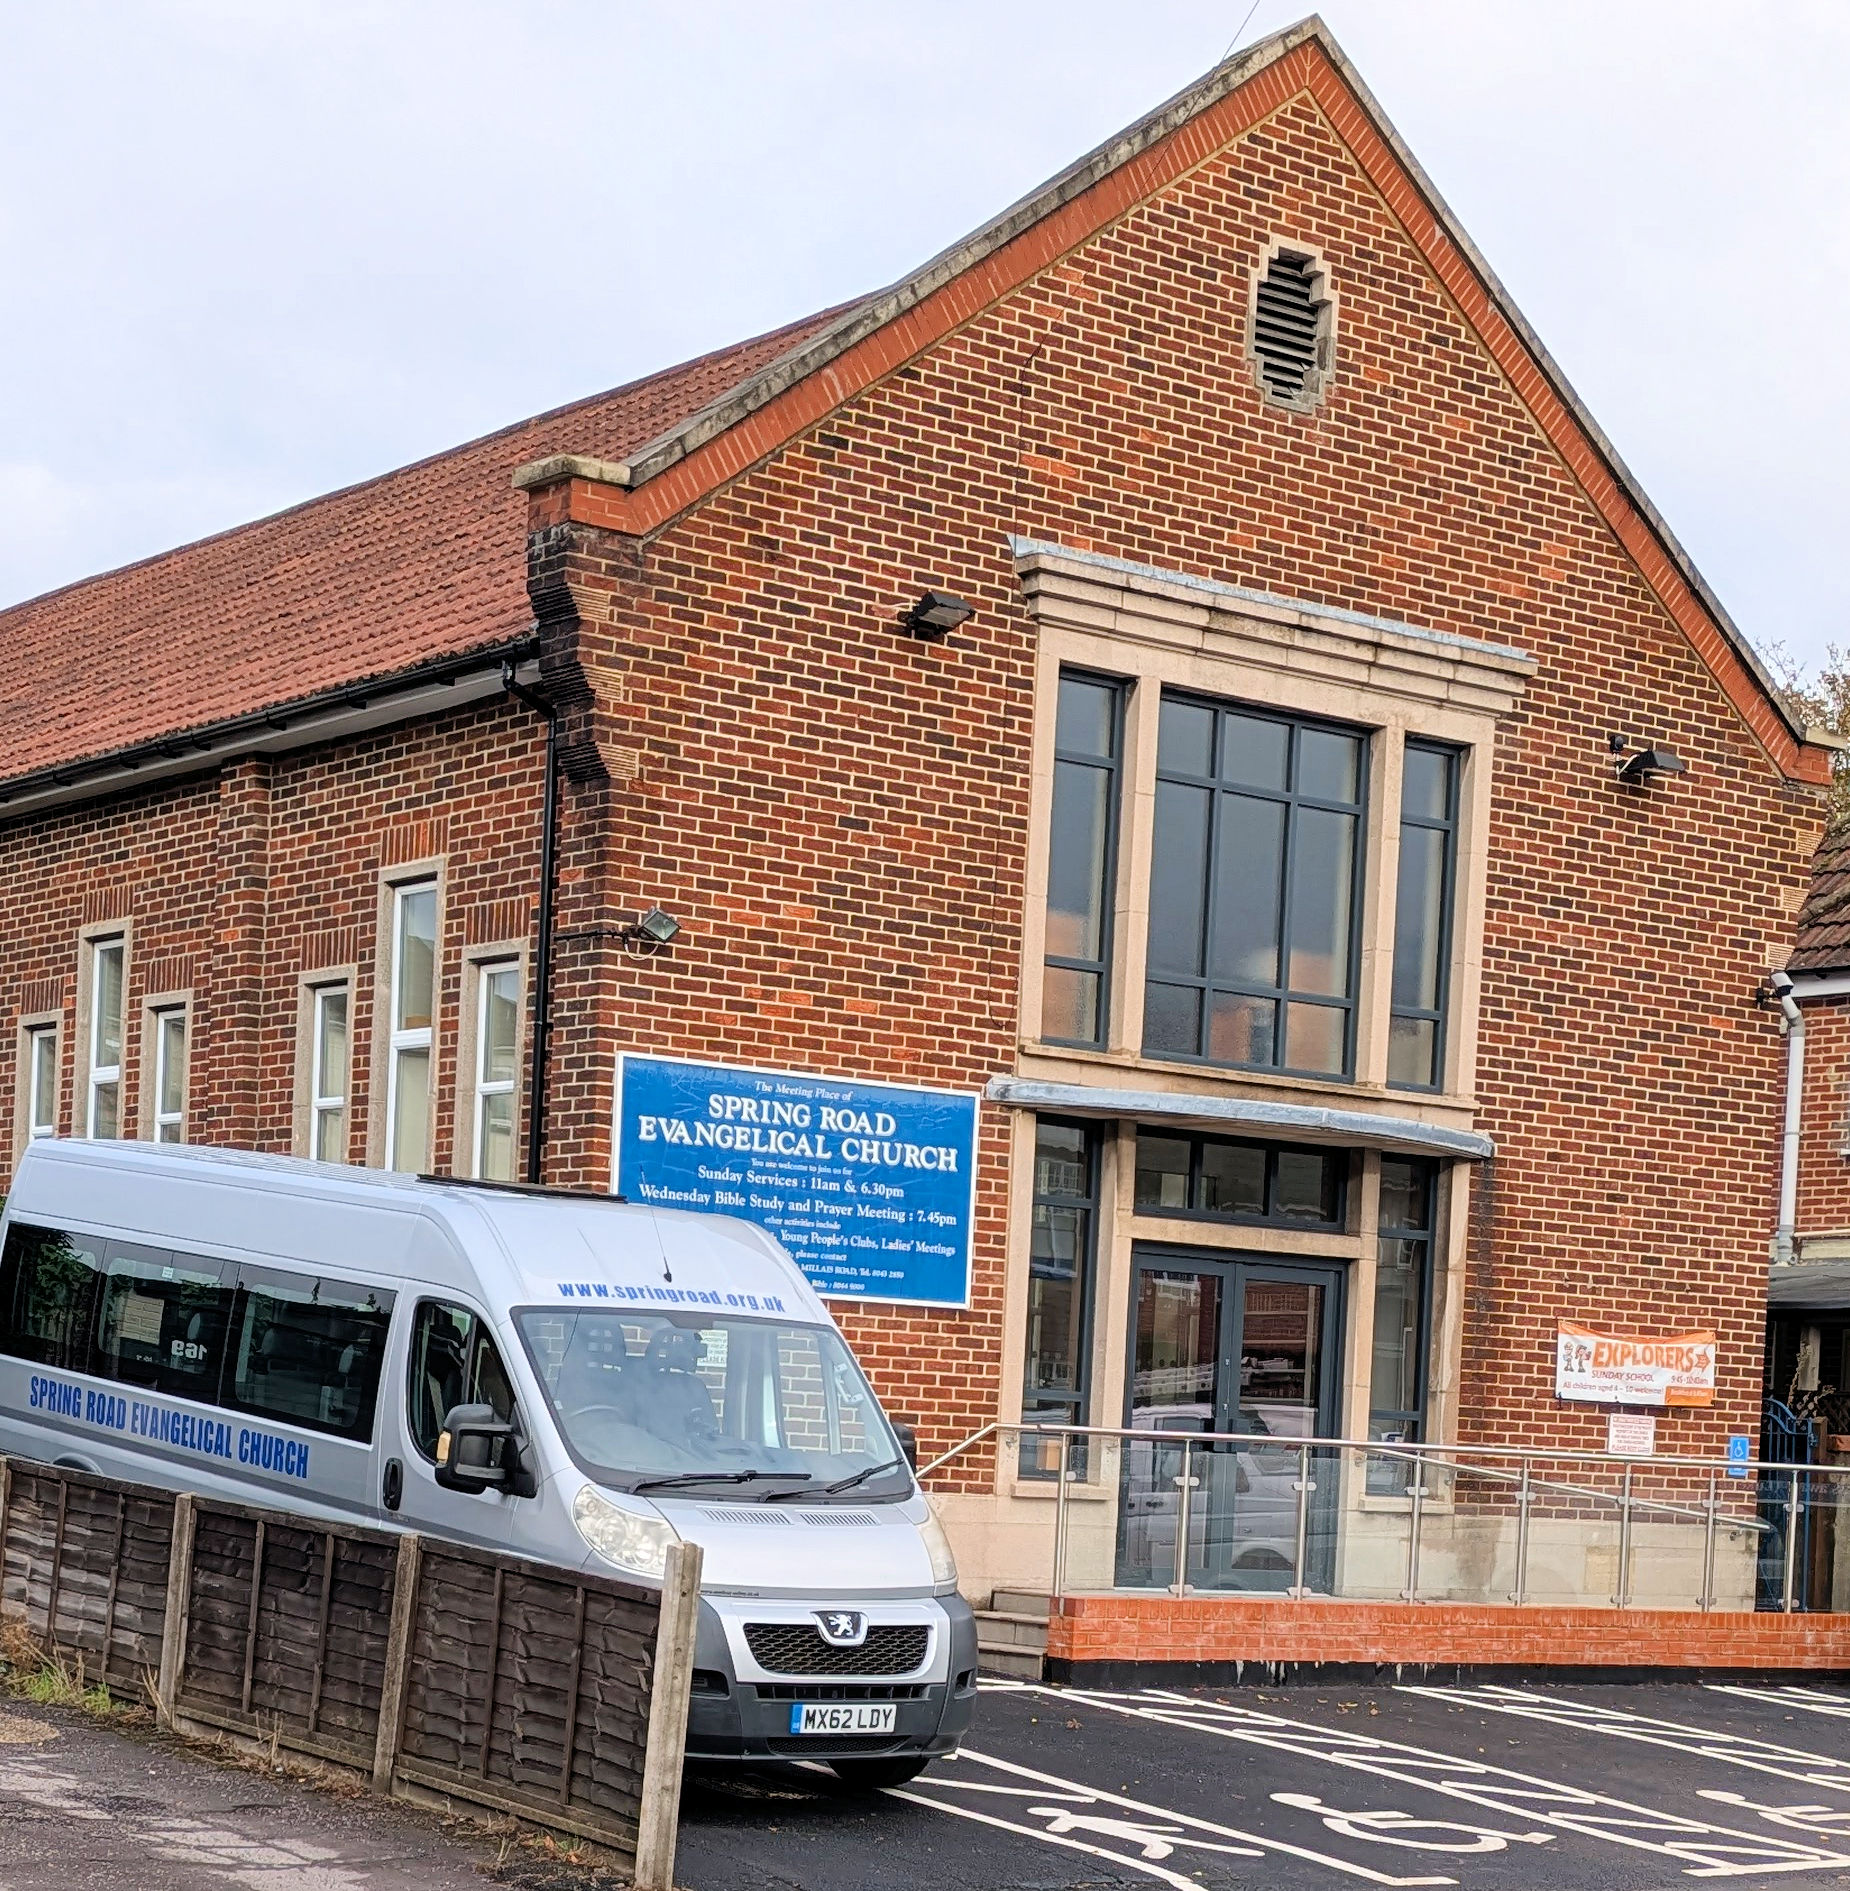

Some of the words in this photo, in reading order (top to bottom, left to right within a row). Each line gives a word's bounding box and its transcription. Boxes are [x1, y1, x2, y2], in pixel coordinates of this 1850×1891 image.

[755, 1081, 772, 1092] The
[775, 1082, 813, 1099] Meeting
[815, 1087, 839, 1100] Place
[842, 1090, 853, 1100] of
[708, 1093, 811, 1127] SPRING
[819, 1106, 897, 1136] ROAD
[638, 1115, 832, 1159] EVANGELICAL
[841, 1137, 958, 1172] CHURCH
[698, 1165, 743, 1185] Sunday
[746, 1169, 798, 1188] Services
[811, 1176, 841, 1192] 11am
[844, 1179, 857, 1193] &
[861, 1181, 904, 1199] 6.30pm
[639, 1183, 711, 1205] Wednesday
[715, 1190, 746, 1206] Bible
[750, 1193, 785, 1212] Study
[788, 1198, 810, 1212] and
[814, 1199, 853, 1217] Prayer
[857, 1203, 905, 1222] Meeting
[917, 1209, 957, 1226] 7.45pm
[816, 1219, 841, 1230] include
[780, 1229, 808, 1245] Young
[811, 1231, 848, 1247] People's
[850, 1235, 879, 1250] Clubs,
[881, 1237, 914, 1252] Ladies'
[916, 1240, 956, 1257] Meetings
[795, 1249, 819, 1259] please
[820, 1252, 848, 1262] contact
[557, 1283, 786, 1312] www.springroad.org.uk
[1592, 1341, 1694, 1373] EXPLORERS
[1592, 1370, 1624, 1382] SUNDAY
[1625, 1372, 1654, 1383] SCHOOL
[30, 1375, 81, 1419] SPRING
[86, 1390, 127, 1430] ROAD
[131, 1402, 232, 1459] EVANGELICAL
[238, 1428, 310, 1479] CHURCH
[804, 1708, 853, 1729] MX62
[857, 1708, 893, 1729] LDY
